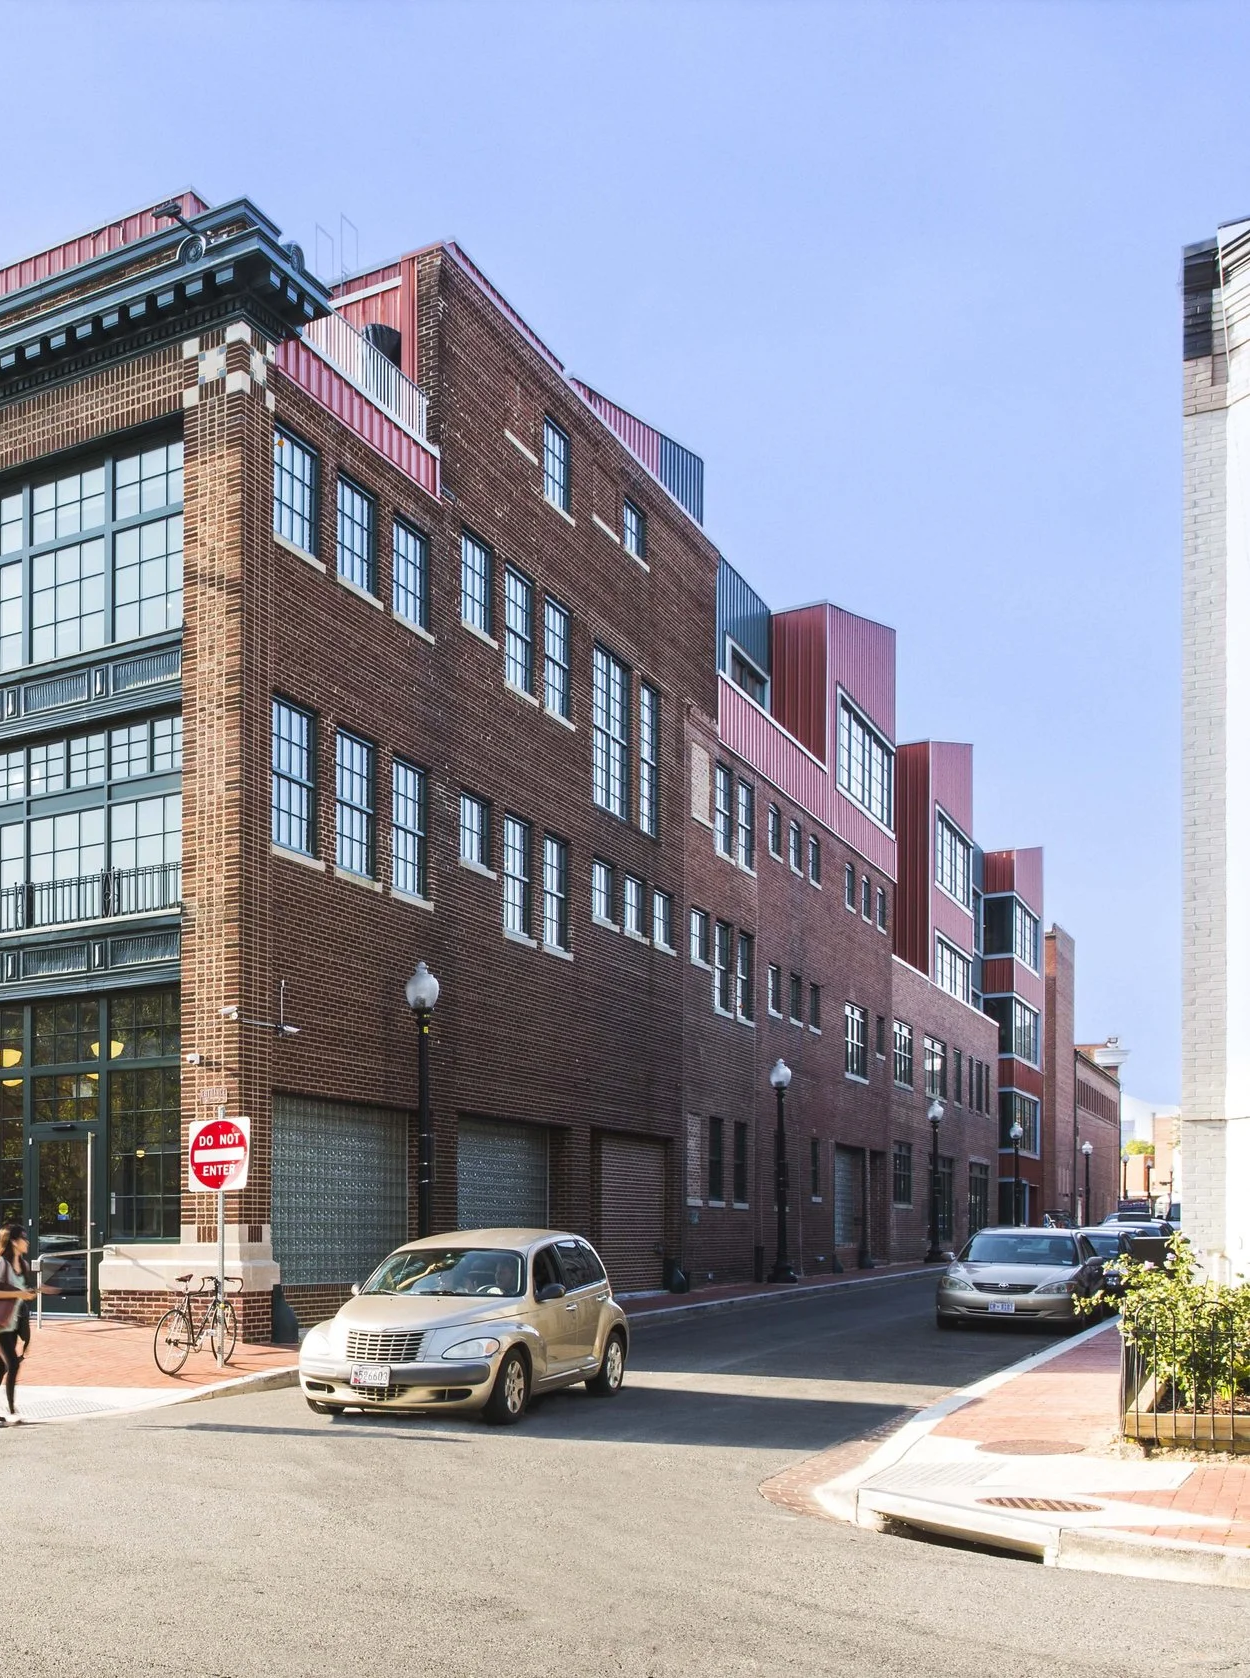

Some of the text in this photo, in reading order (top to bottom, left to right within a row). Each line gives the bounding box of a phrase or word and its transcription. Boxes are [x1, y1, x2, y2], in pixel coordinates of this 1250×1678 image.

[199, 1133, 241, 1147] DO NOT
[202, 1163, 236, 1177] ENTER
